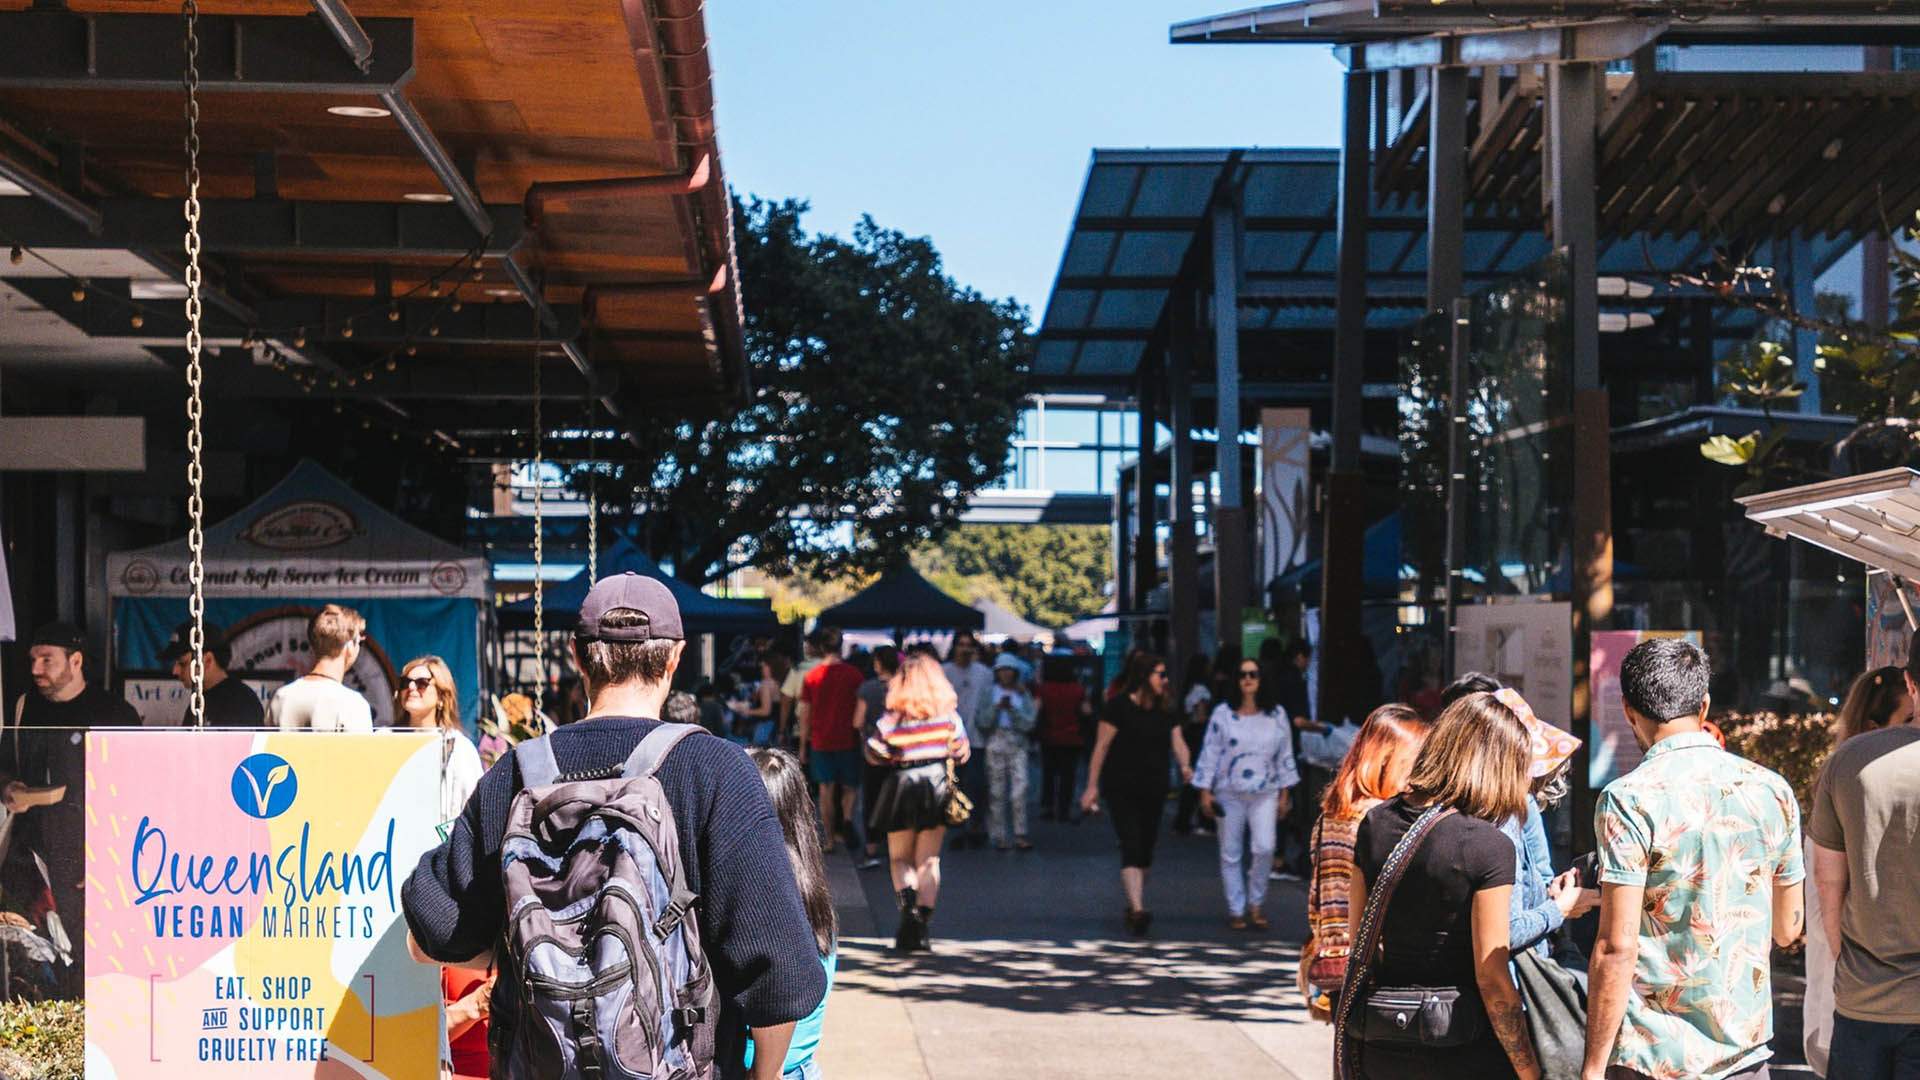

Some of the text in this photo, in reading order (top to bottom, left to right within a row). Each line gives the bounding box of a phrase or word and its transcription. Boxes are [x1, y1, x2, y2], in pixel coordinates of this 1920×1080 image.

[170, 567, 238, 585] Conut
[243, 567, 277, 589] Soft
[283, 567, 329, 585] Serve
[336, 567, 359, 585] Ice
[365, 567, 420, 585] Cream
[132, 815, 396, 912] Queensland
[153, 906, 374, 938] VEGAN MARKETS
[262, 976, 312, 1000] SHOP
[202, 1007, 325, 1031] AND SUPPORT
[198, 1038, 329, 1061] CRUELTY FREE
